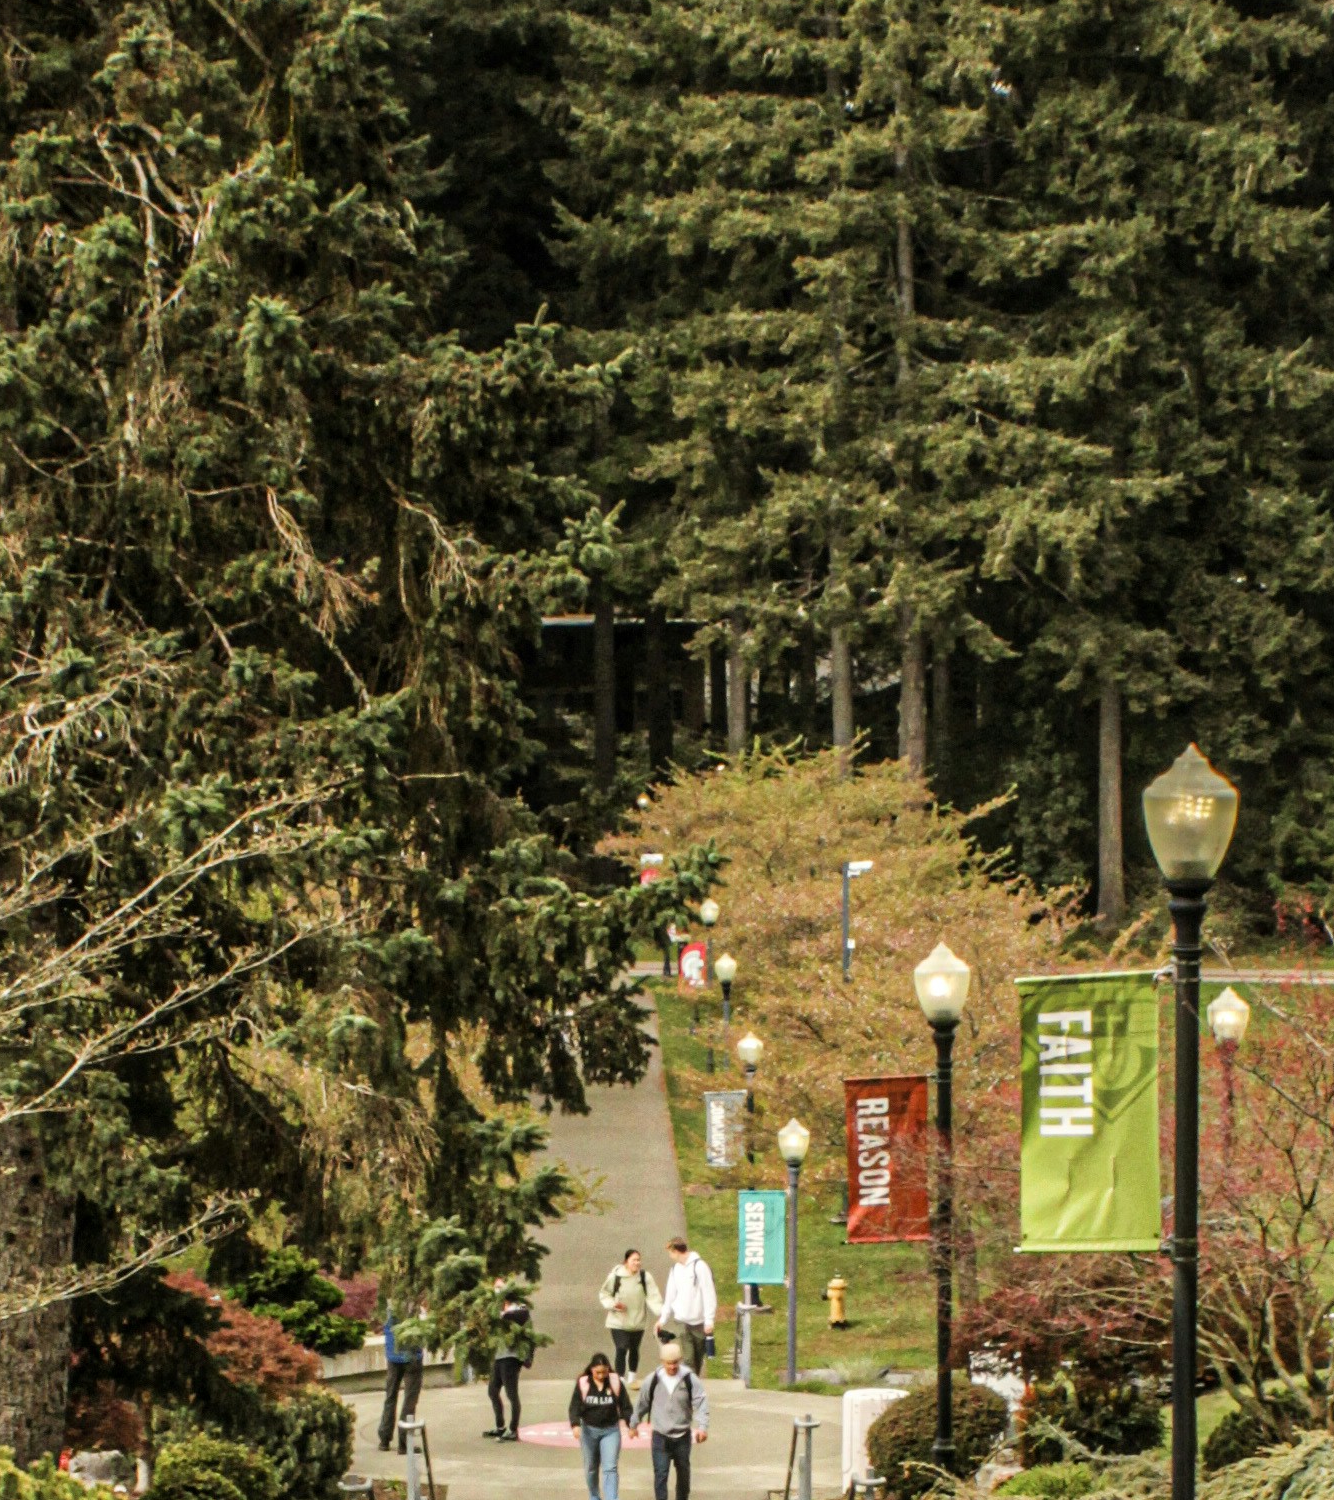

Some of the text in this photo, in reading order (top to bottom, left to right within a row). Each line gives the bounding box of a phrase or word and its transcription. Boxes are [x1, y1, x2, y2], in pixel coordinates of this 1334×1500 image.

[1038, 1009, 1094, 1136] FAITH
[856, 1097, 891, 1206] REASON
[744, 1201, 765, 1267] SERVICE
[585, 1395, 613, 1405] ITALIA
